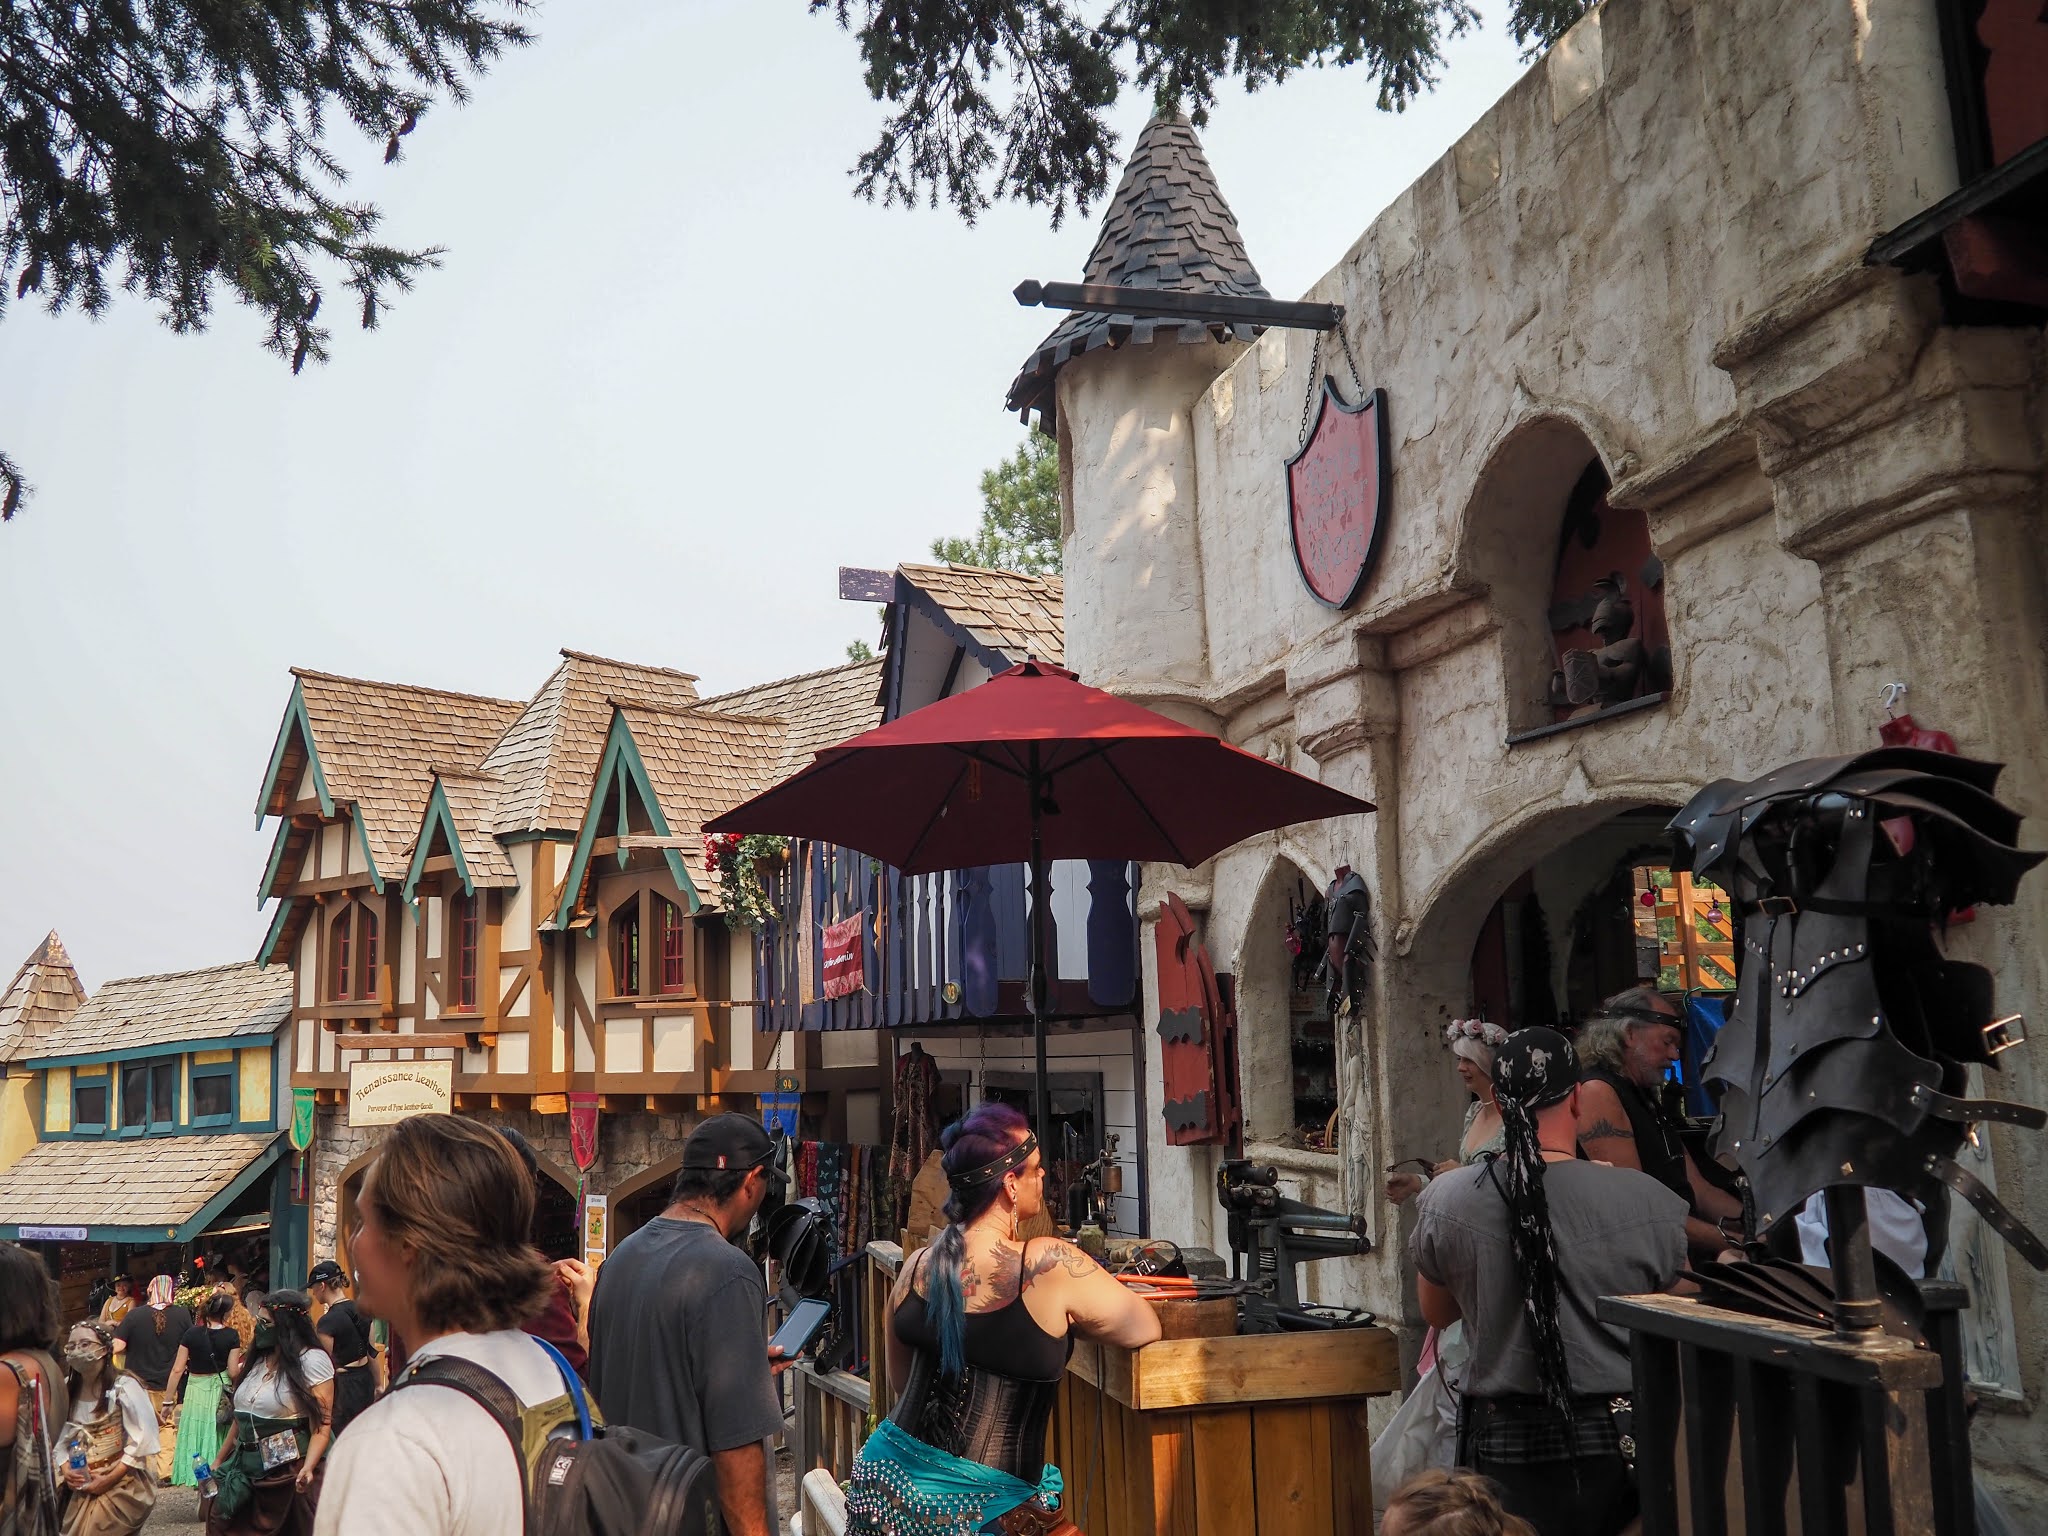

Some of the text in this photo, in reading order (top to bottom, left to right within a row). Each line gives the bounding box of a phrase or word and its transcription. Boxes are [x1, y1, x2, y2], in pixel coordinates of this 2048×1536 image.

[356, 1072, 446, 1101] Renaissance Leather
[783, 1079, 792, 1089] 94
